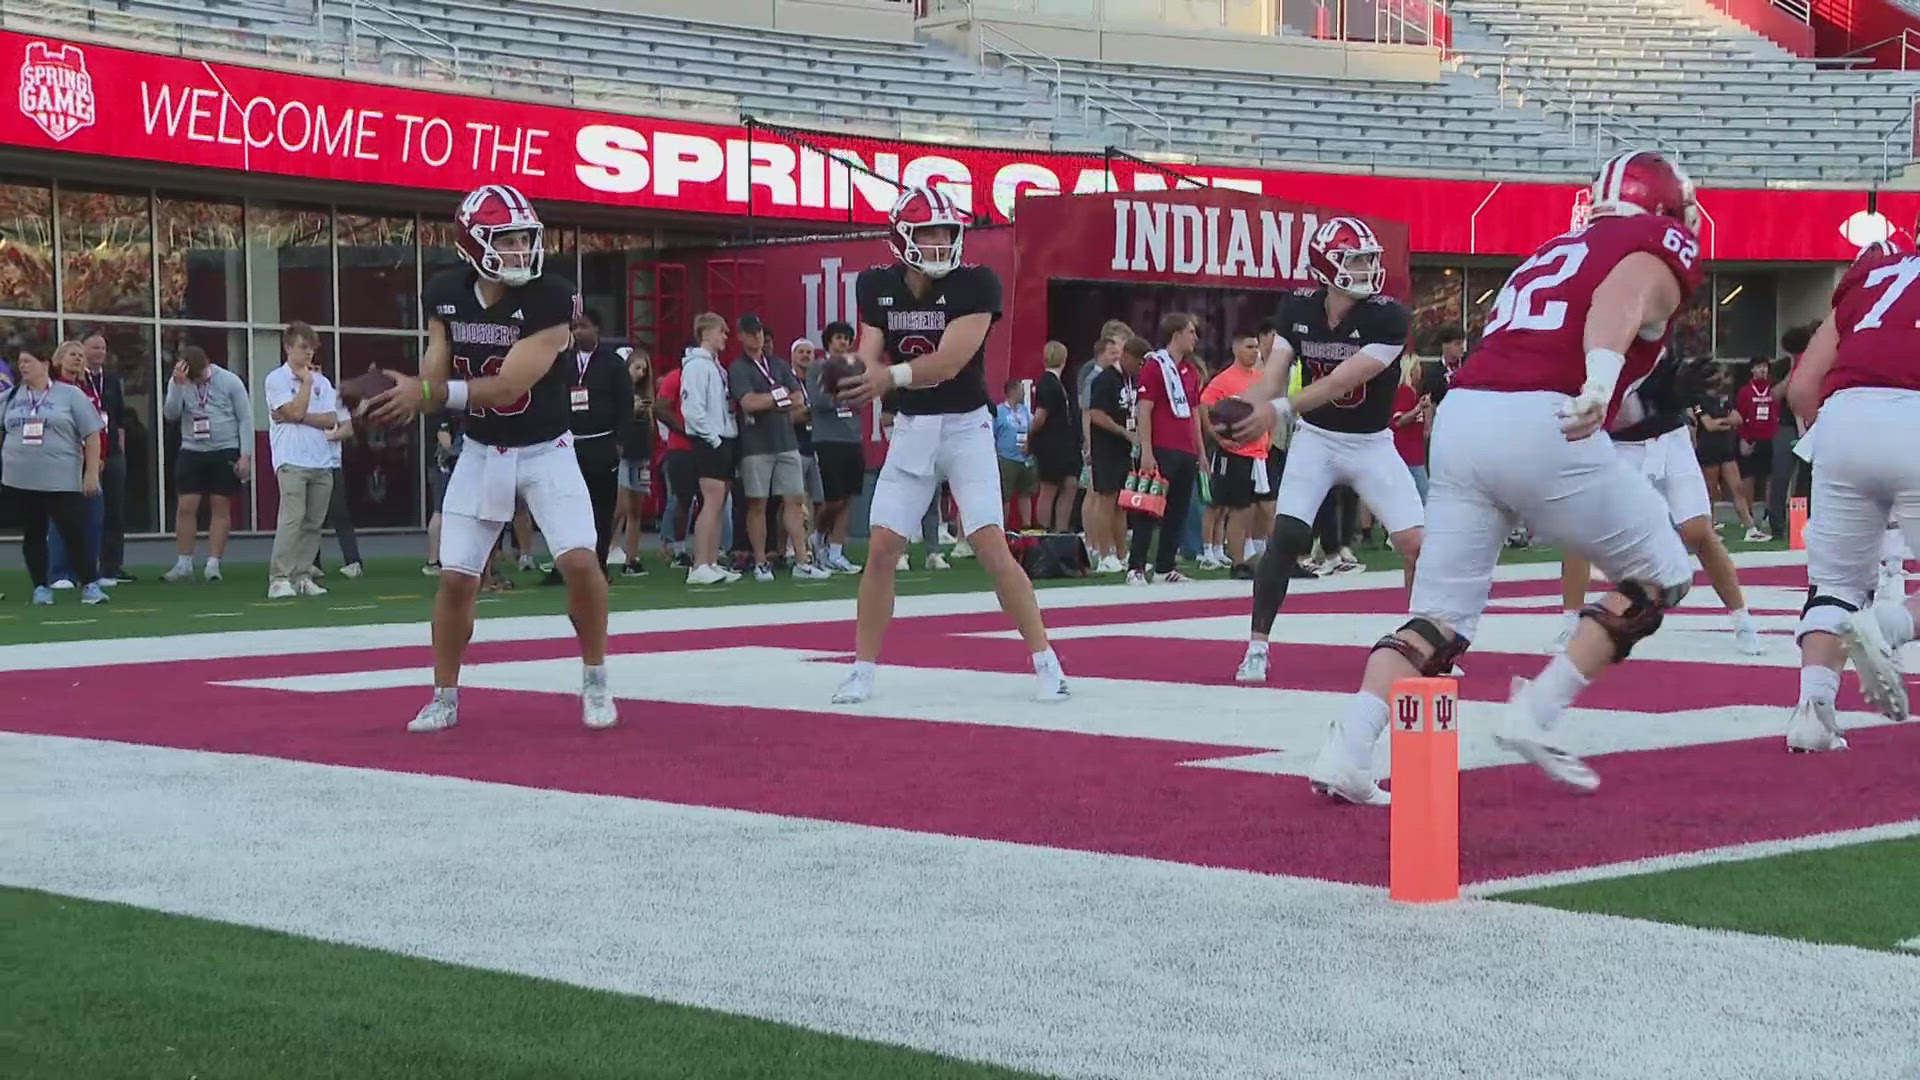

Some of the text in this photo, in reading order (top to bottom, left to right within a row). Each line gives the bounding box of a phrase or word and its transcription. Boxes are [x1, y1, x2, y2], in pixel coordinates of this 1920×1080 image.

[24, 65, 88, 95] SPRING
[23, 84, 91, 120] GAME
[141, 81, 383, 160] WELCOME
[396, 113, 453, 167] TO
[466, 122, 549, 176] THE
[575, 124, 973, 217] SPRING
[1663, 227, 1699, 270] 62
[1853, 256, 1920, 332] 7
